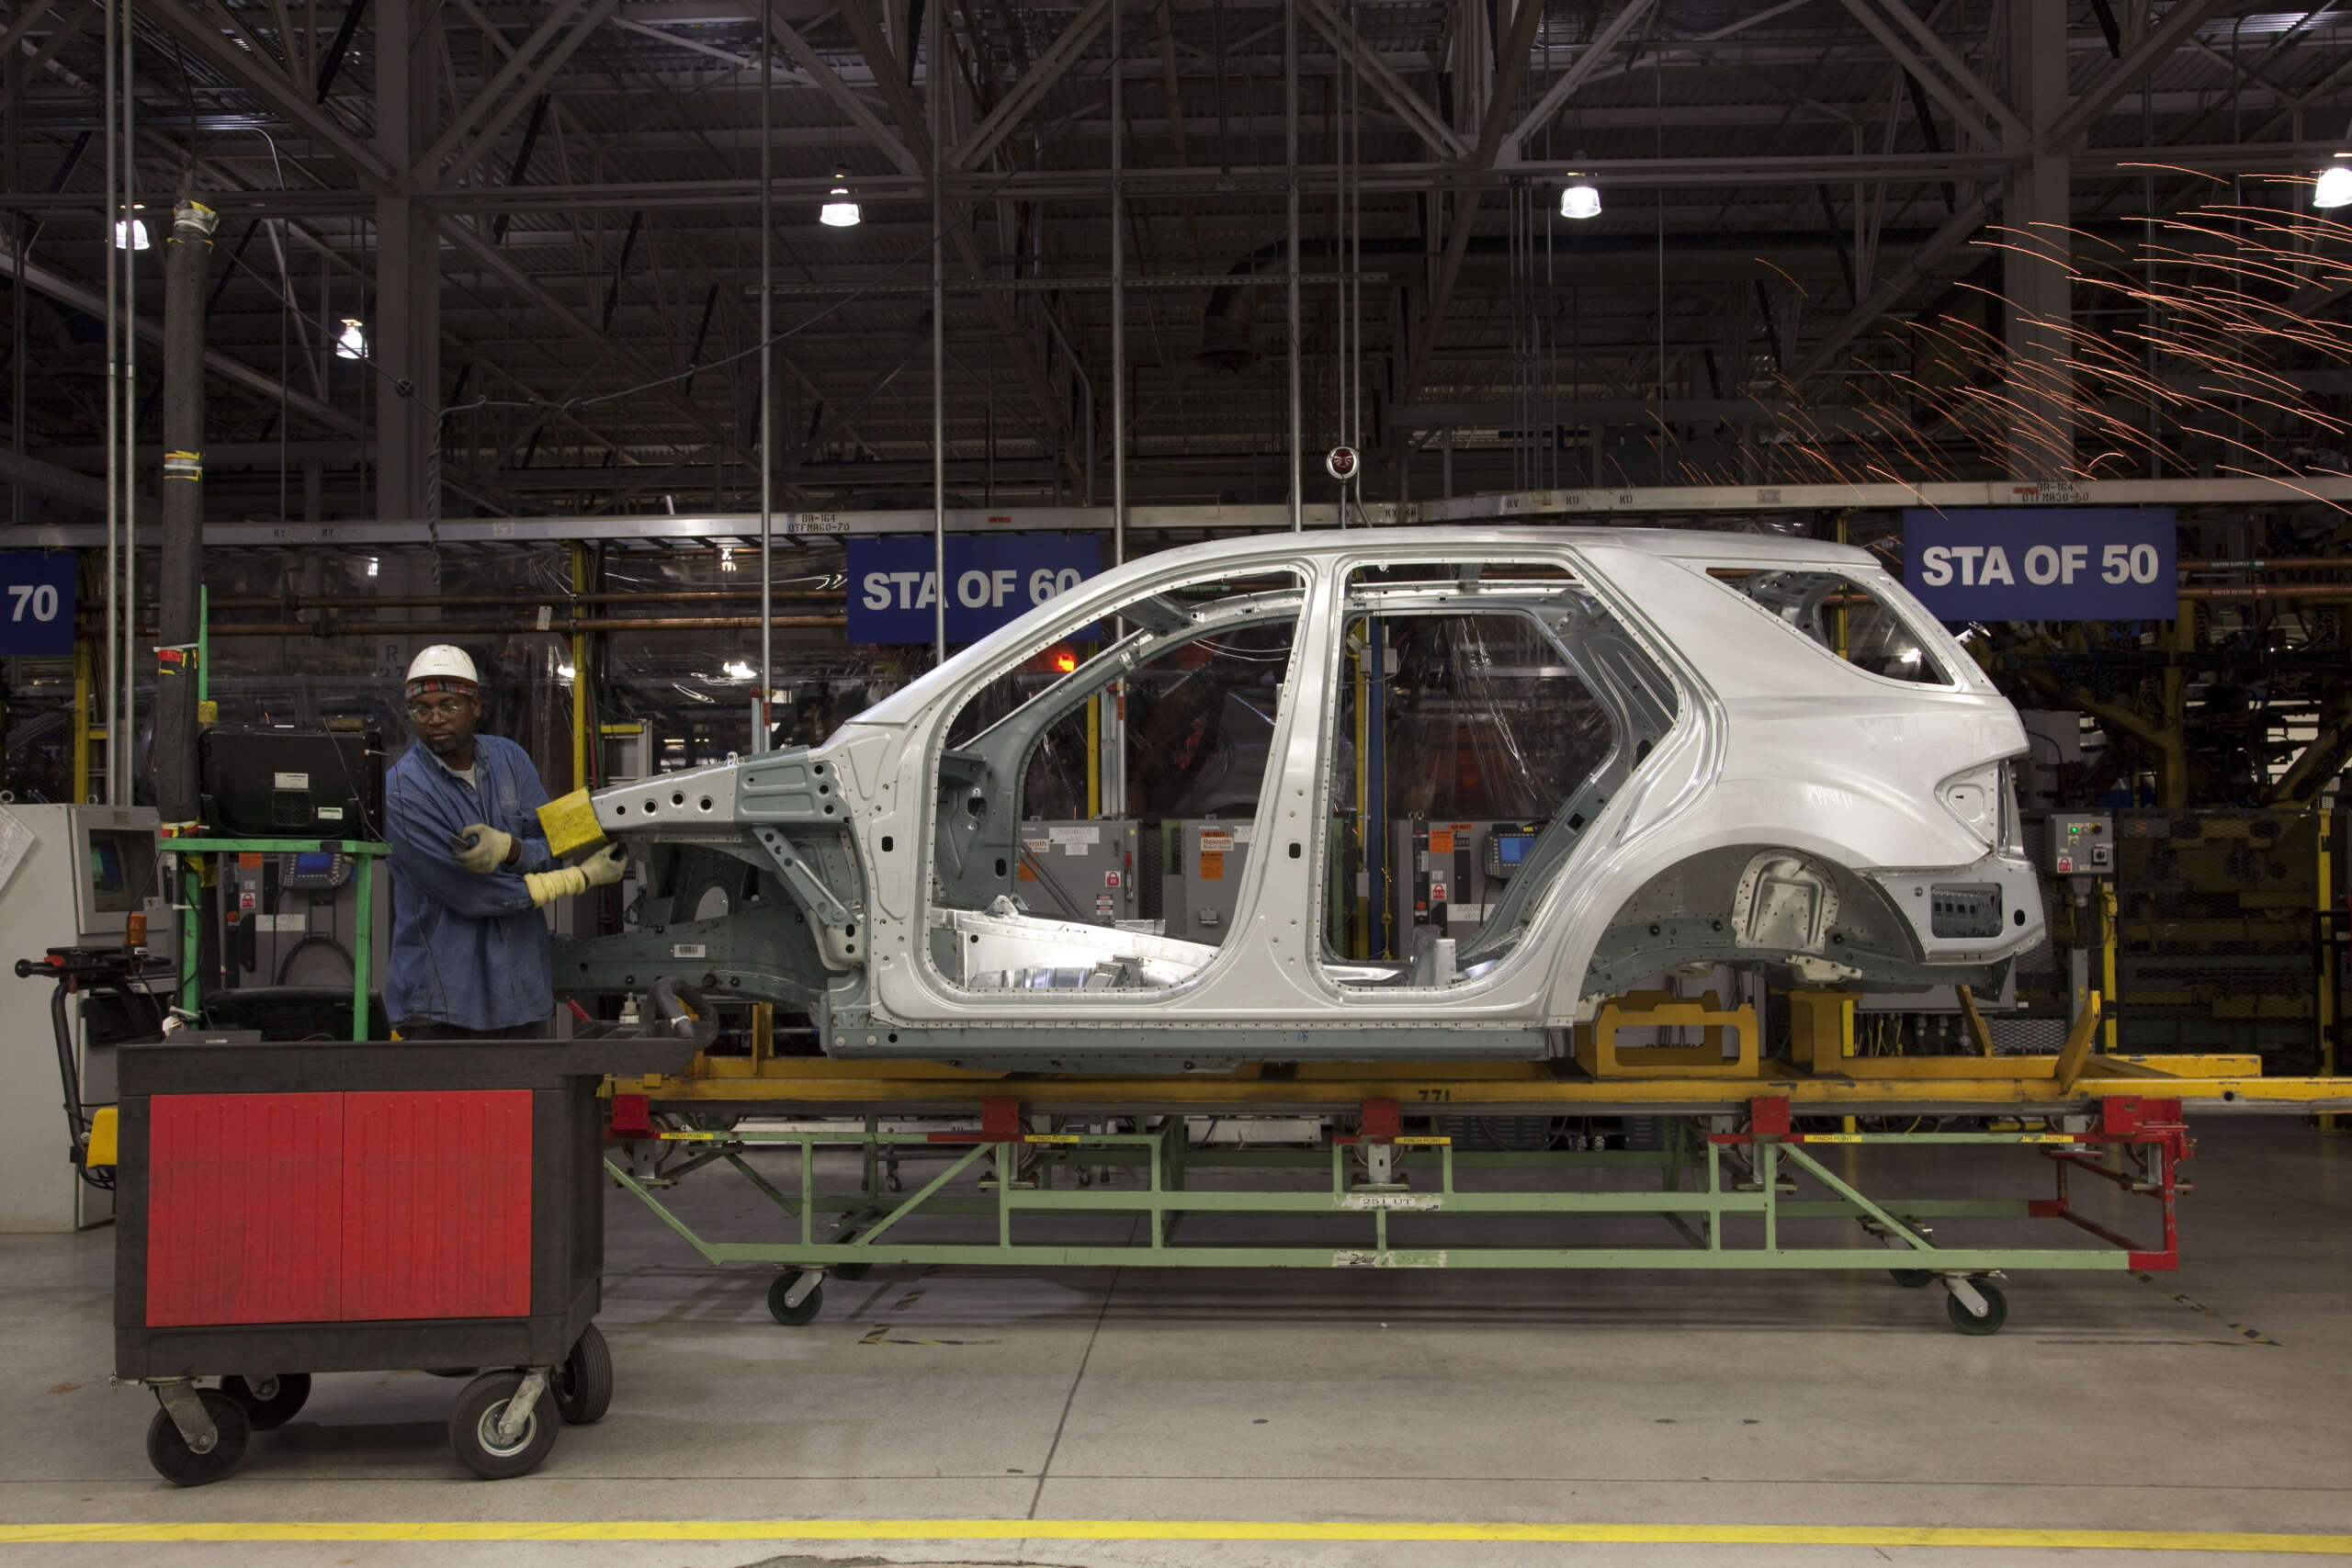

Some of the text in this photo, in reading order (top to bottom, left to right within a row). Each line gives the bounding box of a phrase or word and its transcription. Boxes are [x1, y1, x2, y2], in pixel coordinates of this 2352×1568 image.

[1922, 543, 2159, 587] STA OF 50
[7, 584, 58, 622] 70
[862, 567, 1082, 611] STA OF 60
[1418, 1089, 1451, 1101] 771
